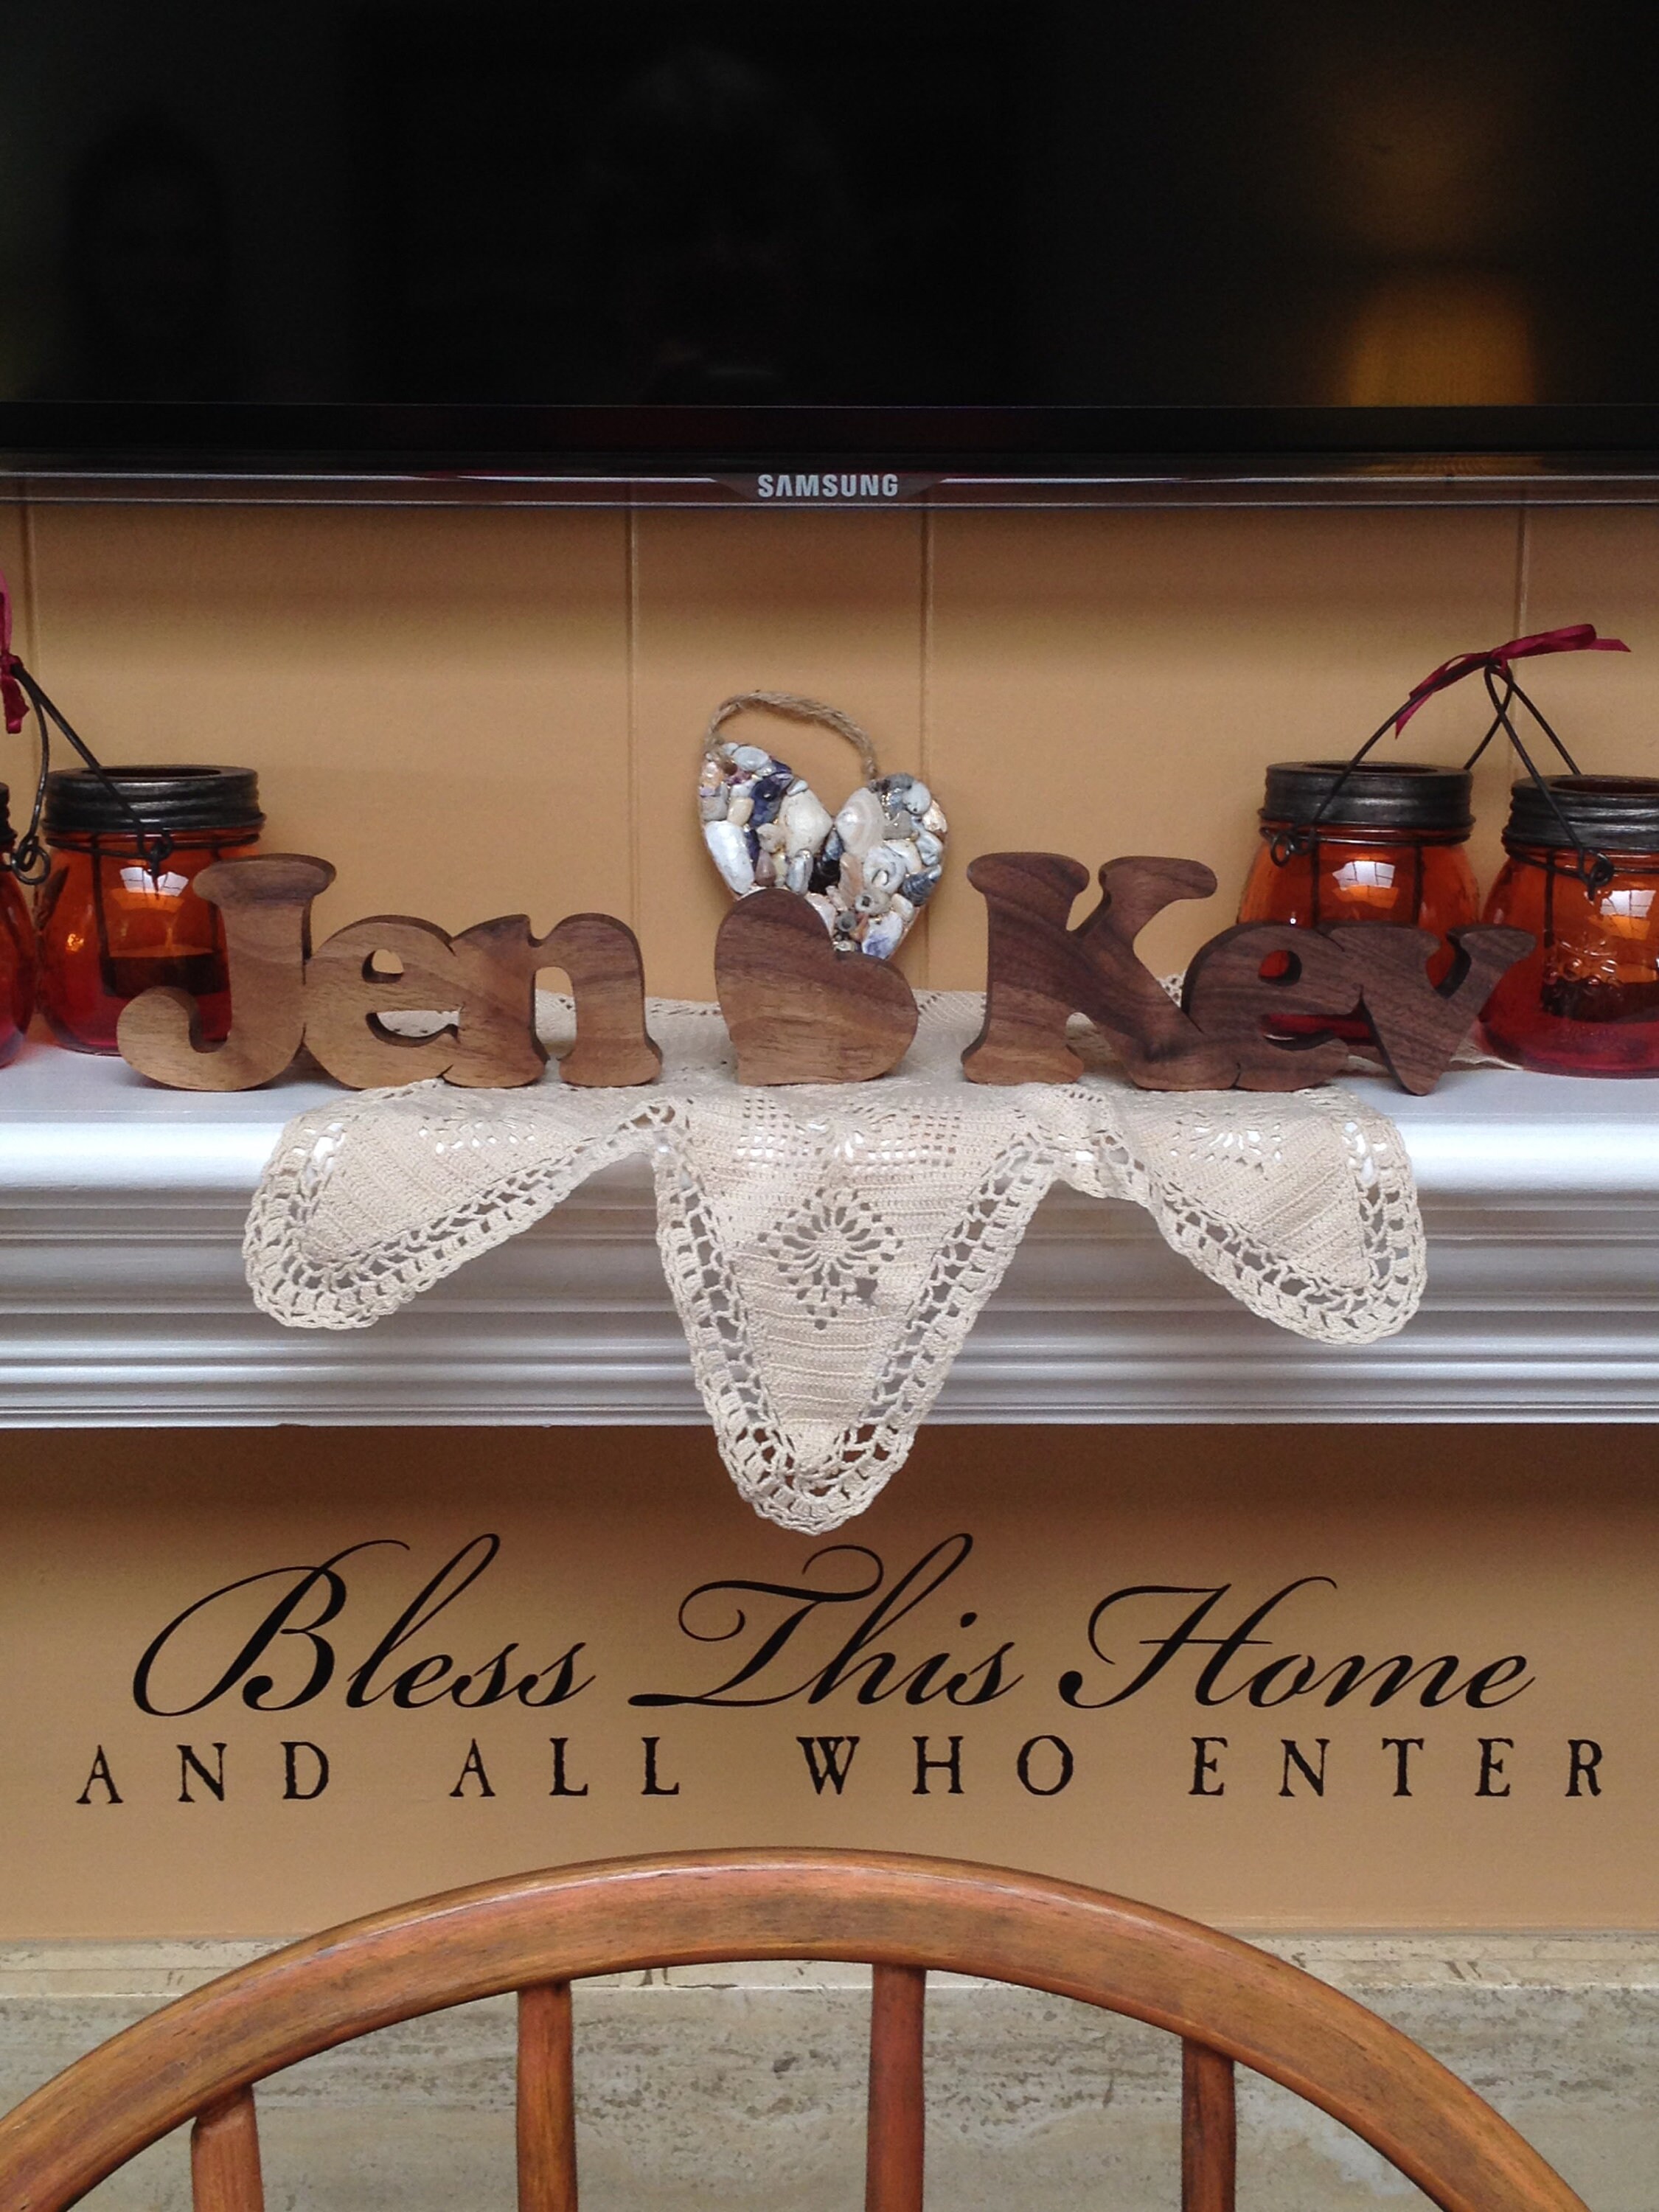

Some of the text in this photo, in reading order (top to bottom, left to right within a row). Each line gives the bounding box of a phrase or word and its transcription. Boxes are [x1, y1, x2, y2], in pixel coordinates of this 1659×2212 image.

[757, 473, 899, 498] SAMSUNG
[116, 853, 664, 1091] Jen
[133, 1533, 1536, 1717] Bless This Home
[76, 1734, 1604, 1805] AND ALL WHO ENTER
